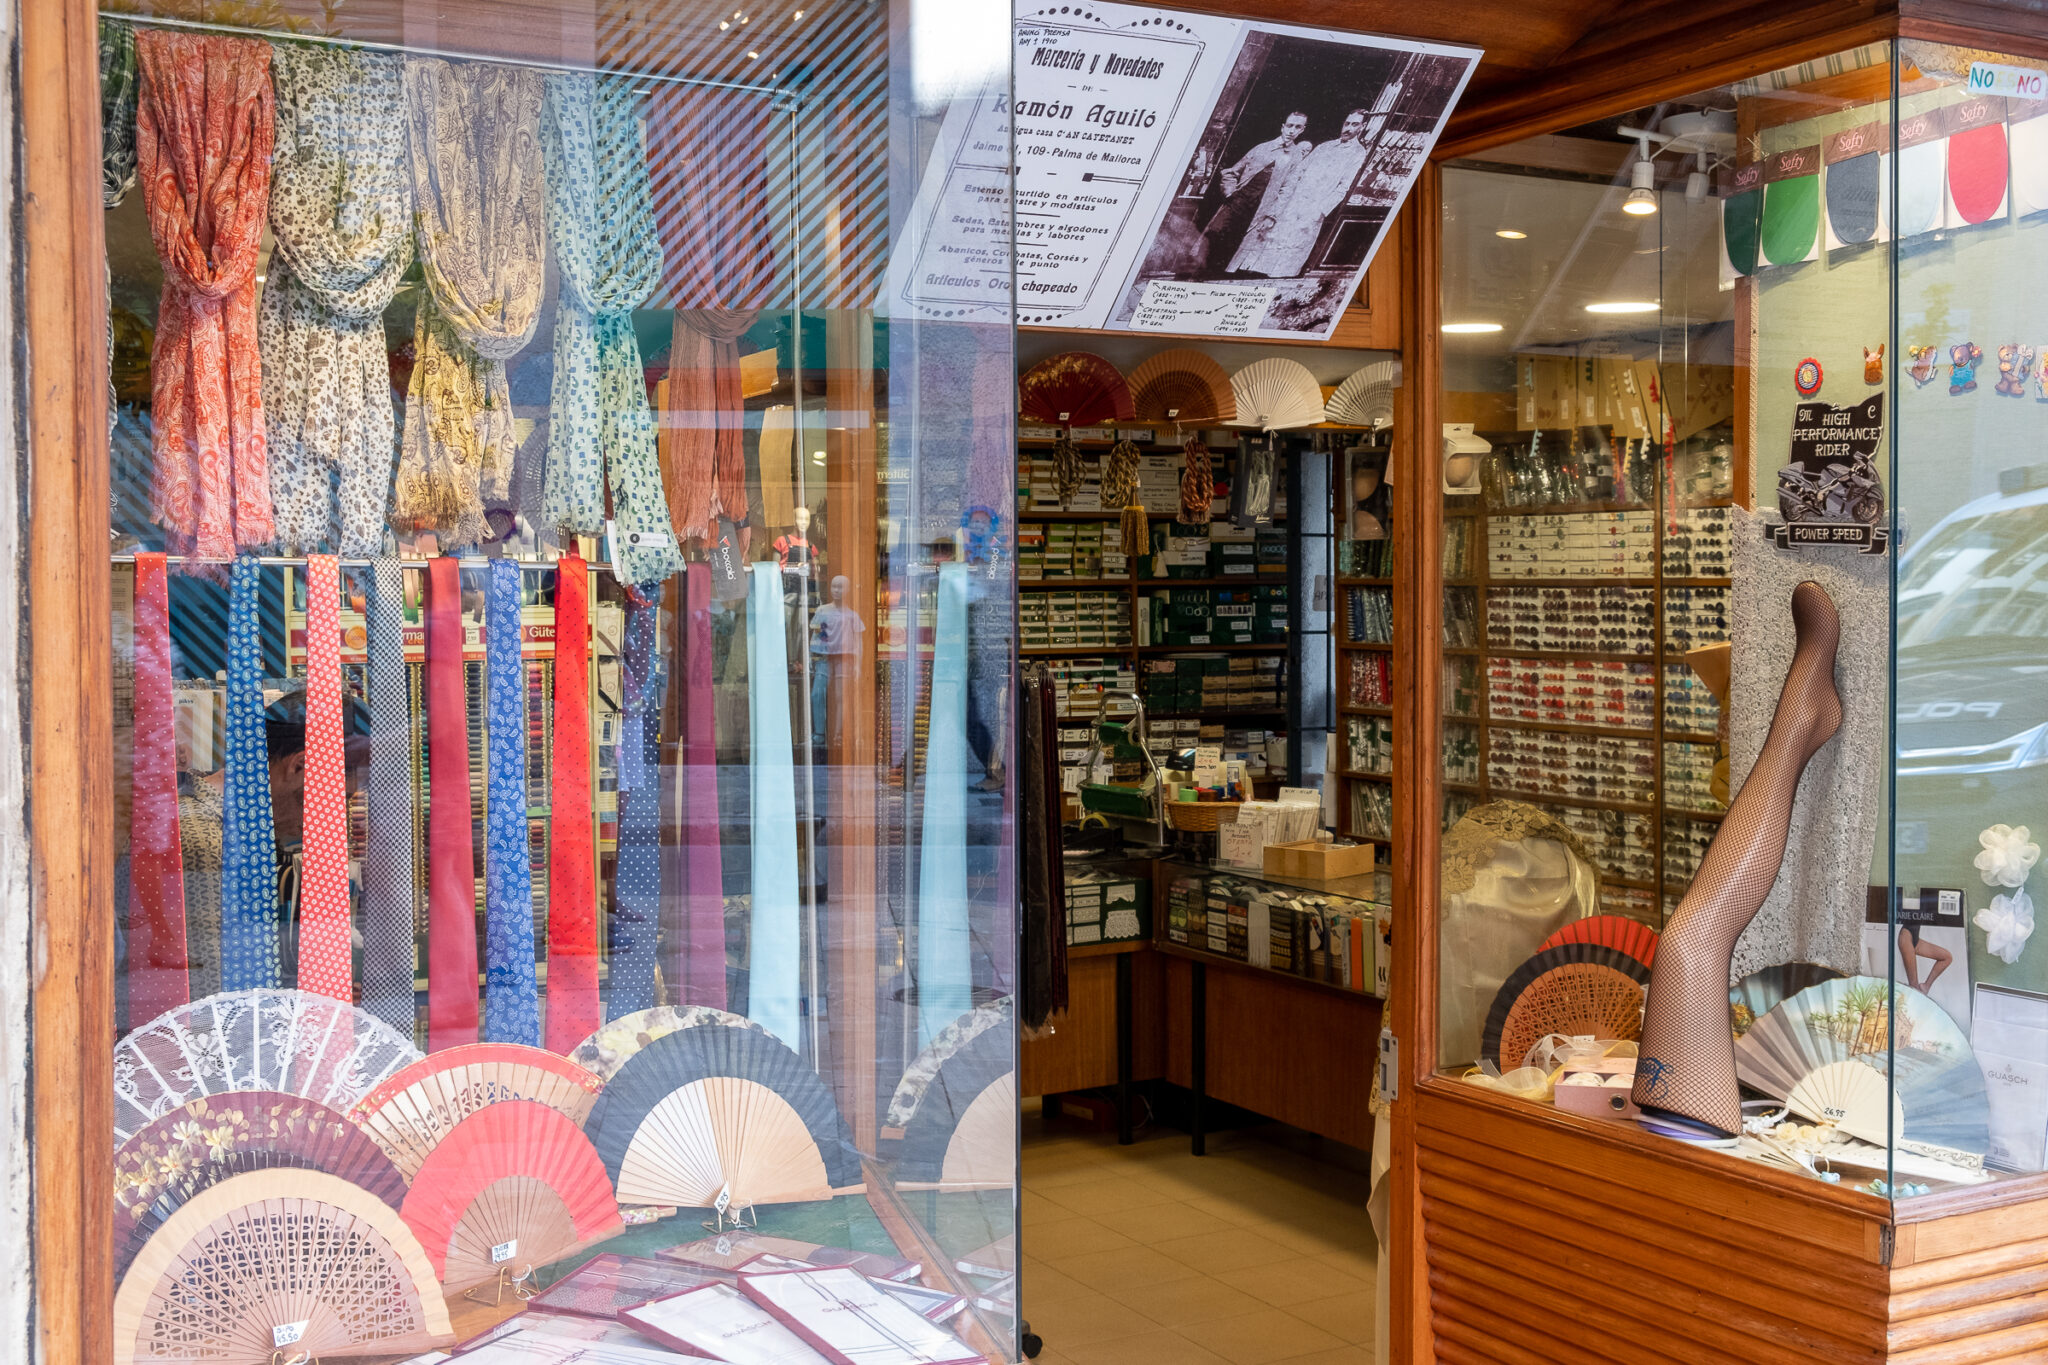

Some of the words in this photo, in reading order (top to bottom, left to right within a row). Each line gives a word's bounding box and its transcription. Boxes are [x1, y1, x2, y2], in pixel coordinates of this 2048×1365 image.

[1089, 53, 1101, 75] y
[1104, 52, 1164, 80] Novedades
[1970, 67, 1994, 88] NO
[2016, 75, 2042, 94] NO
[1085, 103, 1157, 128] Aguiló
[1960, 102, 1989, 122] Softy
[1036, 127, 1054, 138] casa
[1899, 120, 1928, 139] Softy
[1838, 132, 1866, 151] Softy
[973, 140, 1004, 153] Jaime
[1085, 150, 1098, 161] de
[1101, 151, 1142, 166] Mallorca
[1779, 154, 1806, 172] Softy
[1735, 167, 1761, 186] Softy
[963, 183, 1005, 196] Estenso
[1056, 193, 1068, 201] en
[977, 195, 1001, 204] para
[1040, 200, 1047, 209] y
[1050, 201, 1097, 212] modistas
[962, 225, 986, 235] para
[1037, 231, 1044, 239] y
[1048, 230, 1086, 242] labores
[1048, 223, 1055, 232] y
[1057, 223, 1109, 236] algodones
[938, 244, 990, 257] Abanicos,
[1046, 251, 1081, 263] Corsés
[1082, 256, 1089, 264] y
[963, 254, 1003, 266] géneros
[1029, 260, 1060, 270] punto
[987, 277, 1011, 290] Oro
[1021, 280, 1079, 295] chapeado
[1822, 413, 1851, 426] HIGH
[1793, 427, 1878, 442] PERFORMANCE
[1815, 443, 1850, 457] RIDER
[1795, 527, 1830, 542] POWER
[1832, 527, 1864, 542] SPEED
[1912, 911, 1934, 921] CLAIRE
[1987, 1070, 2028, 1086] GUASCH
[1824, 1106, 1846, 1119] 26.95
